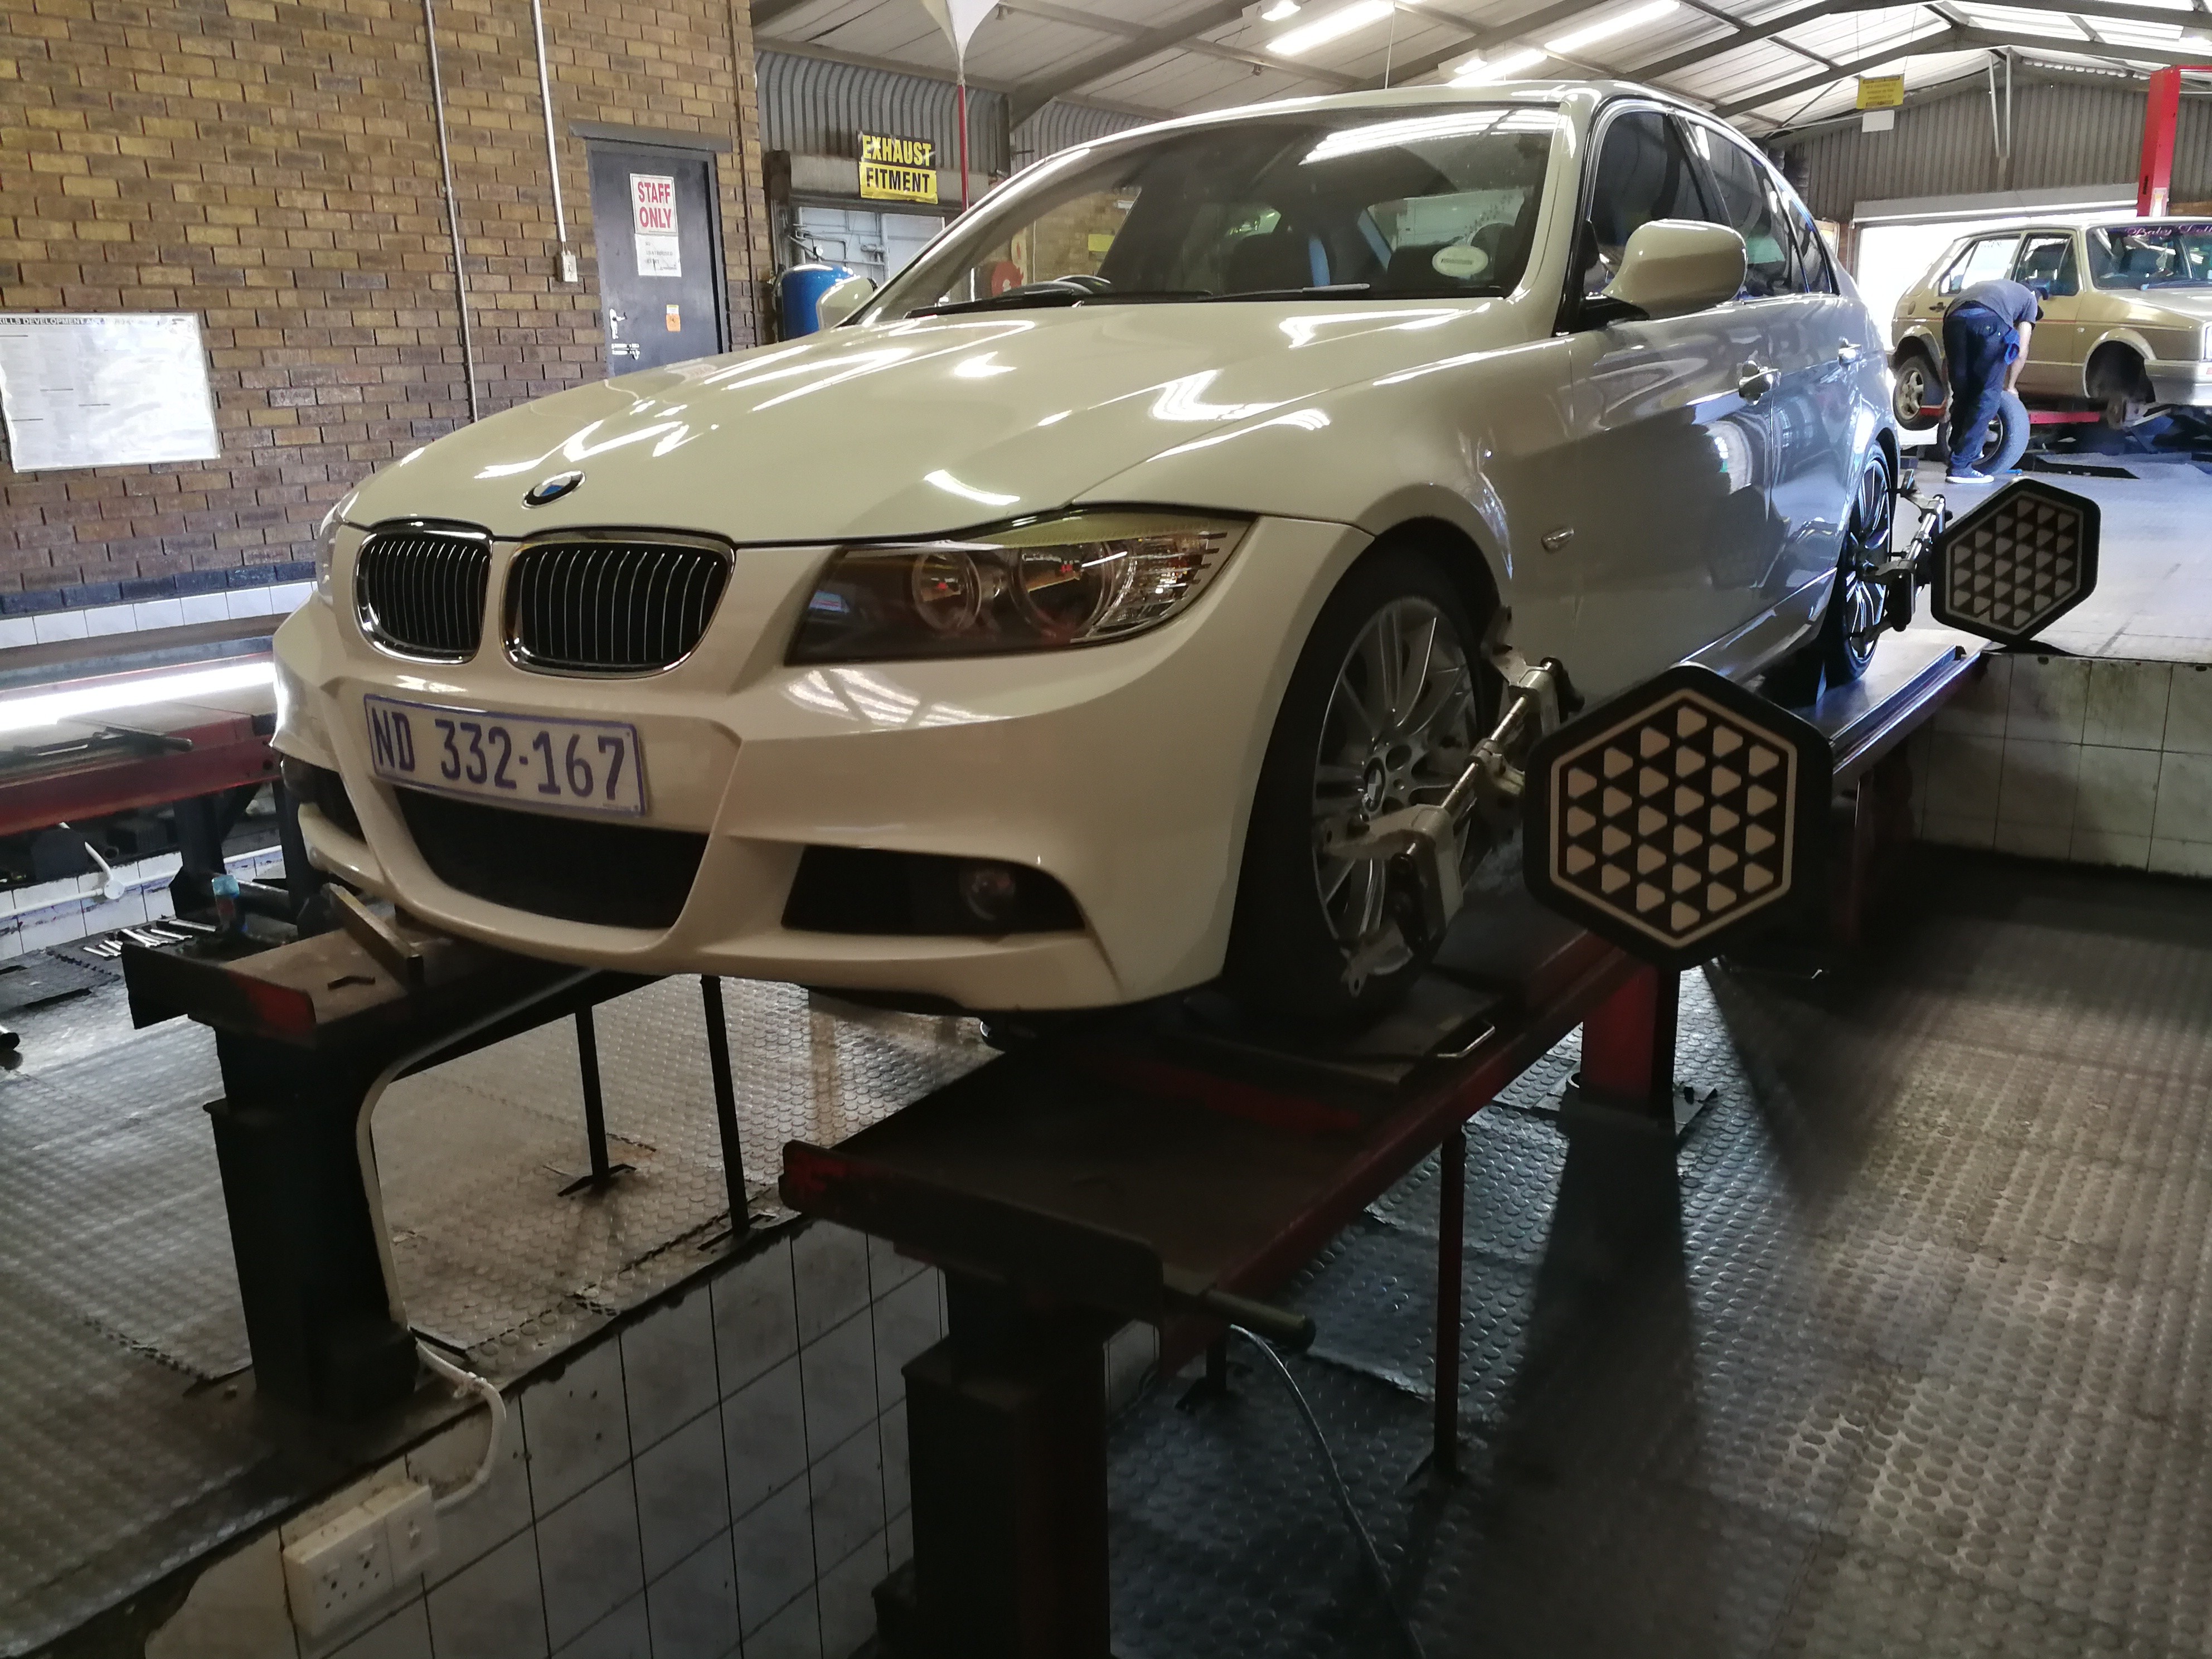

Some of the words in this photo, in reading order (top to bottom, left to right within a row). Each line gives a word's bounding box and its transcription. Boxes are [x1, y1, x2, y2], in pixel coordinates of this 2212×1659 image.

[862, 134, 932, 167] EXHAUST
[638, 181, 671, 204] STAFF
[866, 167, 930, 193] FITMENT
[639, 206, 672, 229] ONLY
[372, 707, 415, 773] ND
